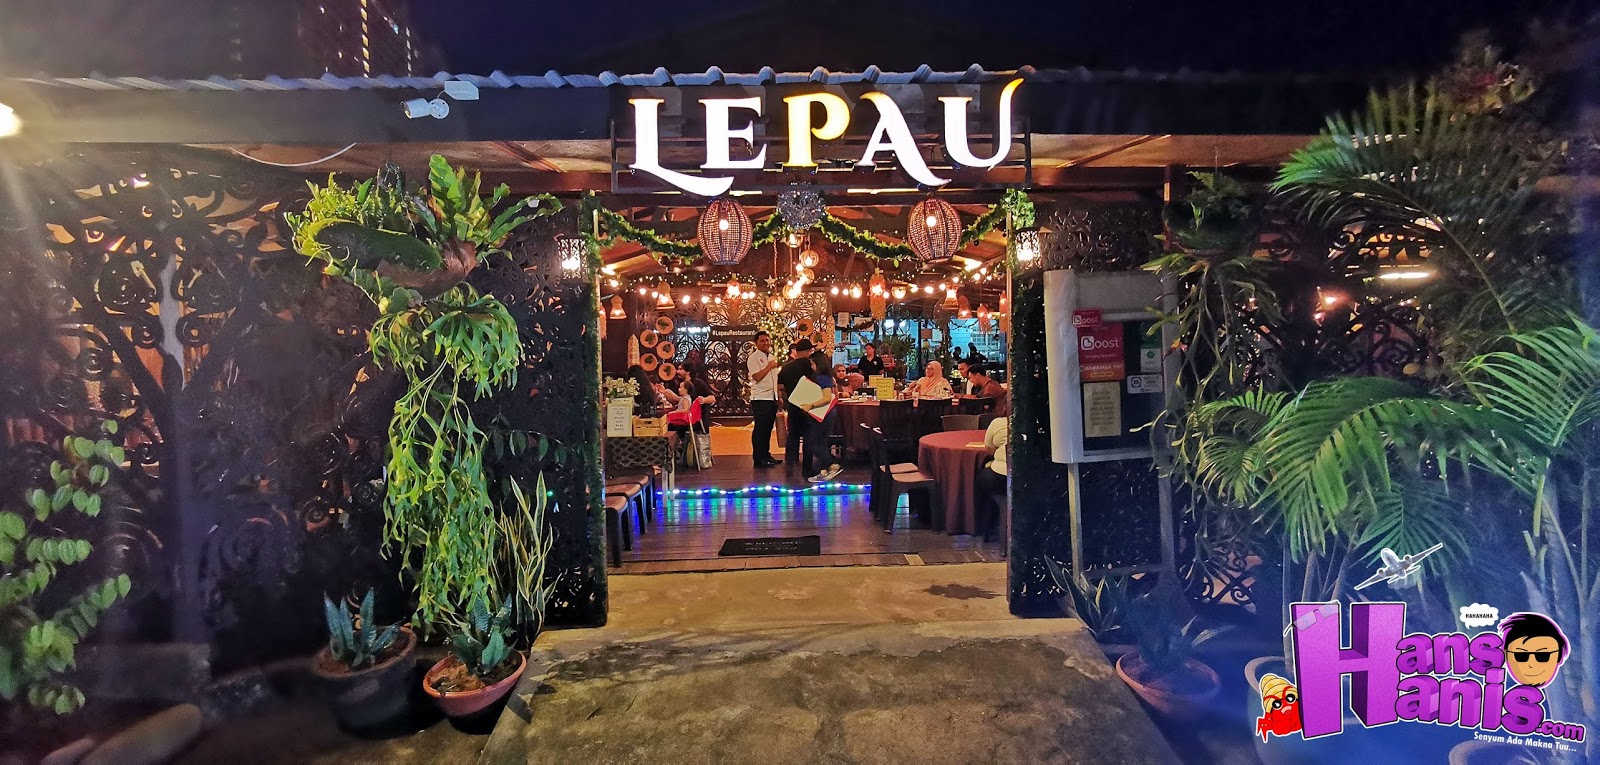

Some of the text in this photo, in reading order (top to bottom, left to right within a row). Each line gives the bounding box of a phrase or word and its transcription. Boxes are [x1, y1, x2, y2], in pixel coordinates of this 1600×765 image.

[627, 78, 1024, 196] LEPAU
[1073, 315, 1098, 325] Boost
[1081, 335, 1120, 350] Boost
